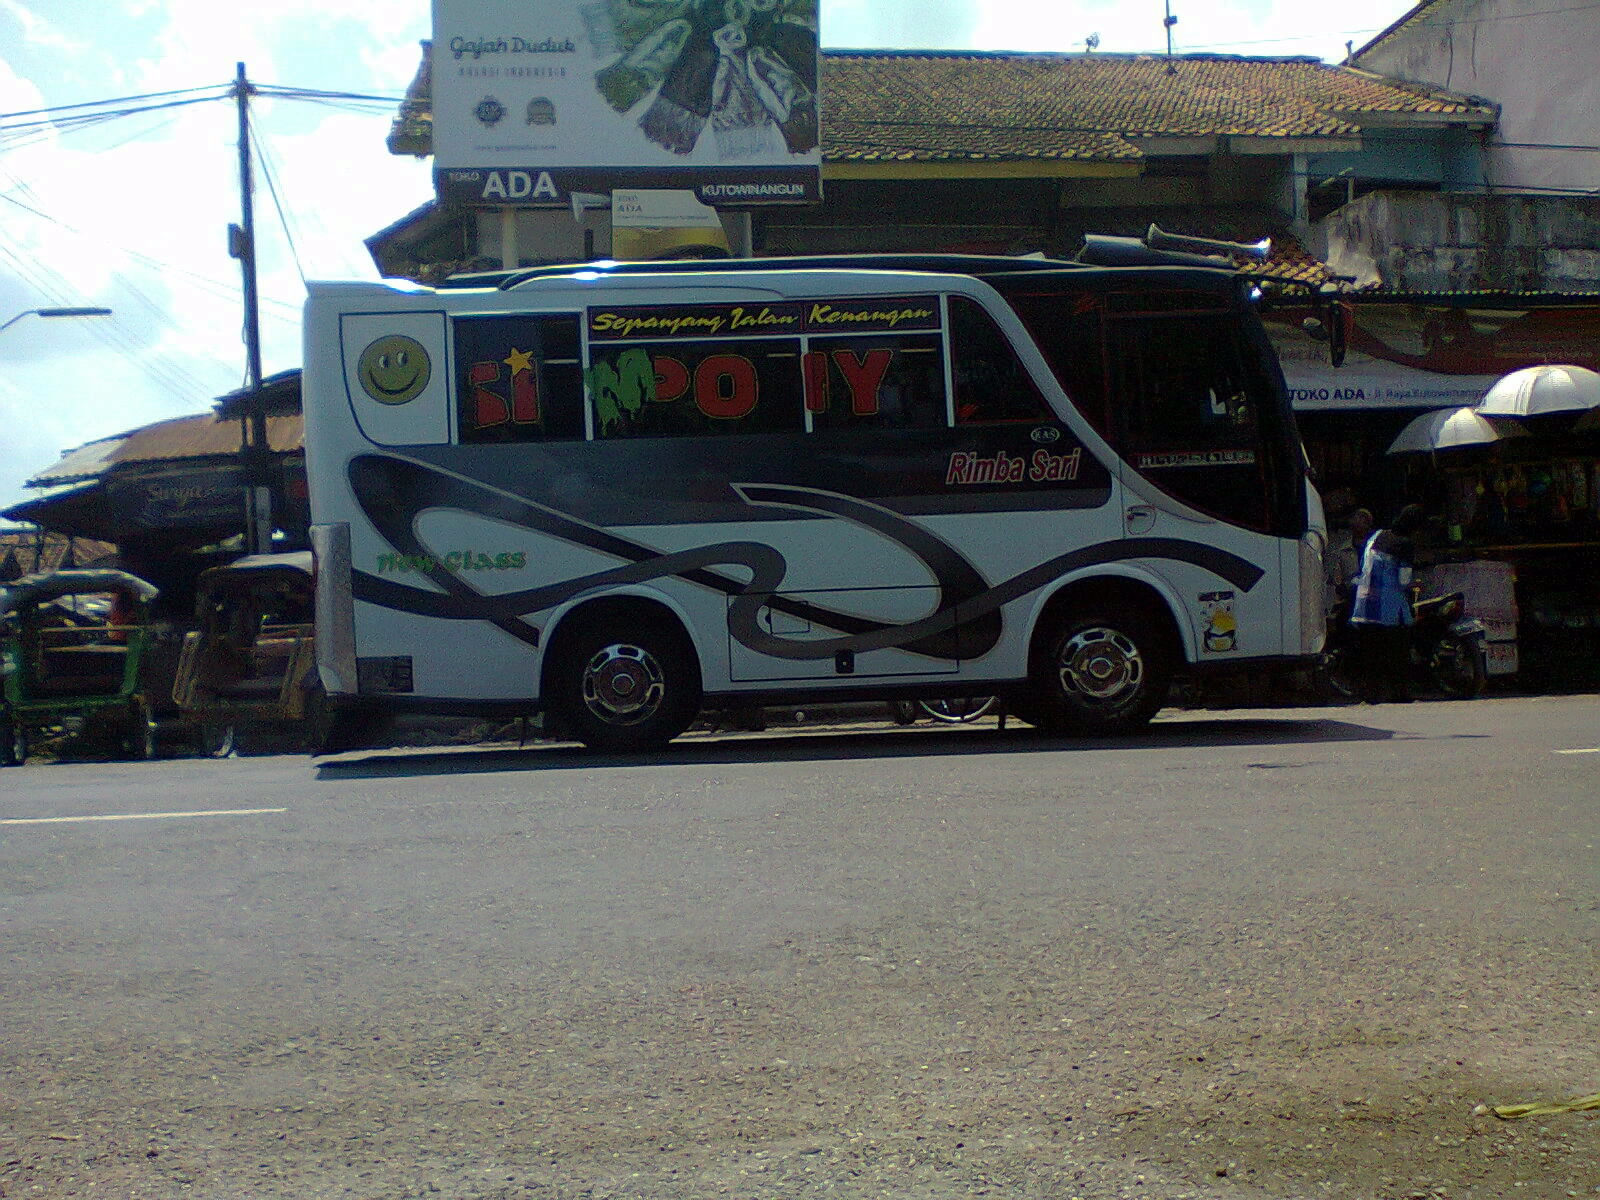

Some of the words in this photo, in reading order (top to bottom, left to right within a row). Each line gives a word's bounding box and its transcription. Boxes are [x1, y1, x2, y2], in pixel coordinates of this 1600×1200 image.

[450, 36, 508, 60] Gajah
[481, 171, 559, 198] ADA
[702, 183, 805, 197] KUTOWINANGUN
[808, 303, 934, 328] Kenangan
[1288, 388, 1329, 401] TOKO
[1333, 388, 1365, 401] ADA
[945, 451, 1026, 486] Rimba
[1029, 447, 1083, 483] Sari
